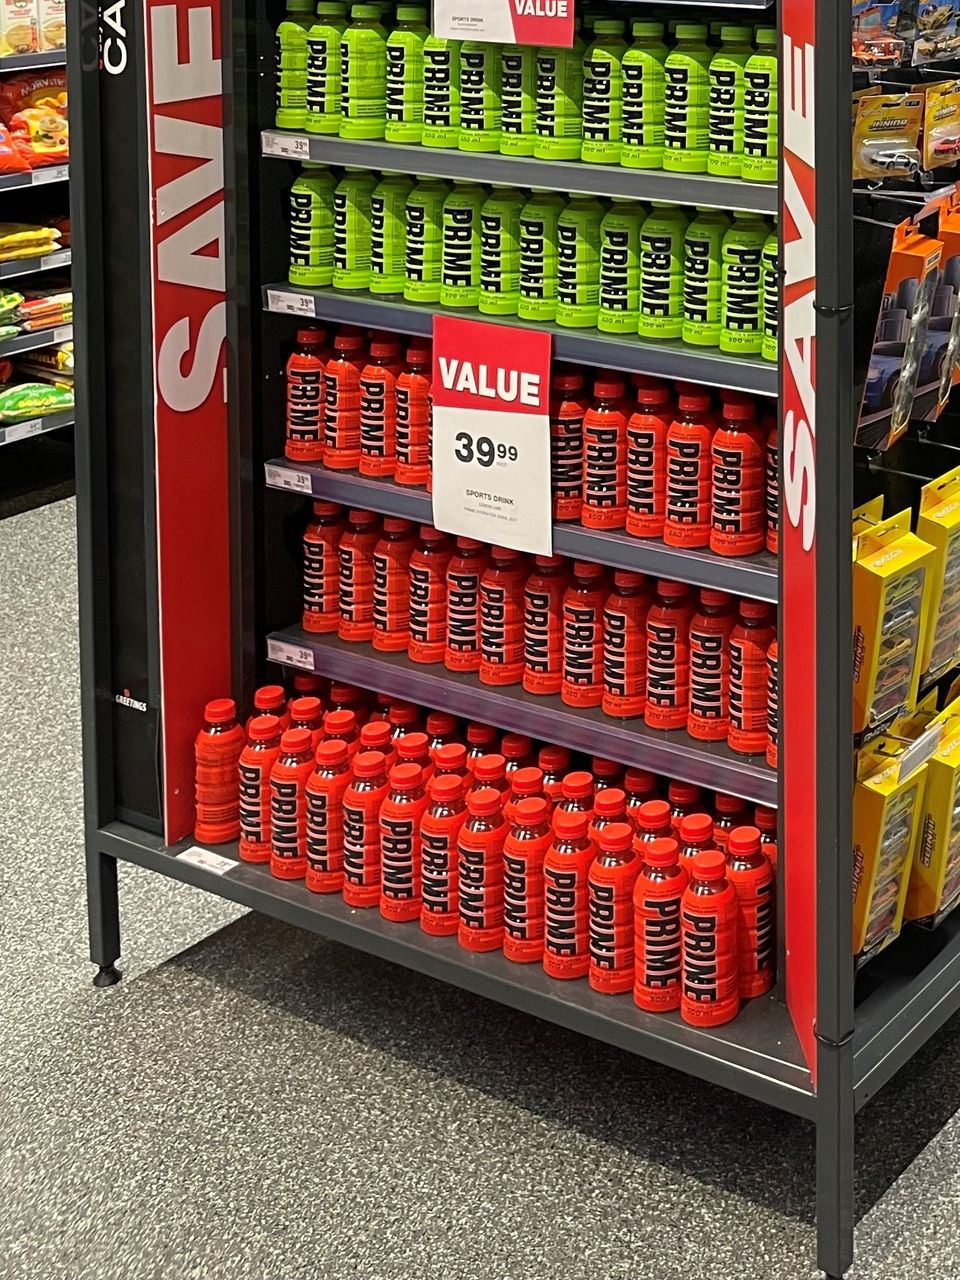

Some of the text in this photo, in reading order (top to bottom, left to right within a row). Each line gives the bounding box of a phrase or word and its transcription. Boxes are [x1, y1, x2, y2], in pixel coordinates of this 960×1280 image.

[307, 38, 328, 114] PRIME
[386, 43, 405, 123] PRIME
[424, 48, 450, 127] PRIME
[460, 51, 486, 131] PRIME
[502, 53, 522, 134] PRIME
[537, 54, 556, 137] PRIME
[583, 60, 612, 142] PRIME
[622, 63, 644, 145] PRIME
[665, 67, 689, 149] PRIME
[709, 69, 736, 153] PRIME
[745, 72, 771, 157] PRIME
[151, 4, 227, 413] SAVE
[290, 192, 313, 266] PRIME
[406, 203, 425, 281] PRIME
[444, 207, 473, 286] PRIME
[481, 214, 501, 293] PRIME
[520, 220, 545, 298] PRIME
[558, 224, 577, 304] PRIME
[601, 230, 629, 311] PRIME
[641, 234, 672, 316] PRIME
[685, 238, 710, 323] PRIME
[726, 247, 762, 331] PRIME
[783, 33, 816, 551] SAVE
[288, 369, 321, 442] PRIME
[360, 379, 386, 456] PRIME
[438, 357, 540, 407] VALUE
[466, 489, 514, 506] SPORTS DRINK
[552, 418, 583, 498] PRIME
[585, 427, 618, 507] PRIME
[627, 429, 654, 515] PRIME
[668, 439, 700, 524] PRIME
[712, 448, 743, 534] PRIME
[304, 539, 325, 614] PRIME
[409, 564, 430, 642] PRIME
[448, 572, 479, 652] PRIME
[480, 582, 505, 664] PRIME
[524, 589, 549, 673] PRIME
[564, 605, 595, 686] PRIME
[604, 609, 626, 697] PRIME
[648, 621, 676, 706] PRIME
[116, 694, 147, 711] GREETINGS
[690, 631, 723, 718] PRIME
[239, 764, 261, 843] PRIME
[271, 780, 298, 857] PRIME
[306, 790, 328, 871] PRIME
[344, 805, 364, 885] PRIME
[381, 818, 414, 900] PRIME
[421, 830, 449, 912] PRIME
[458, 844, 485, 928] PRIME
[504, 853, 528, 939] PRIME
[545, 866, 577, 956] PRIME
[589, 880, 616, 969] PRIME
[644, 897, 681, 988] PRIME
[683, 911, 717, 1002] PRIME
